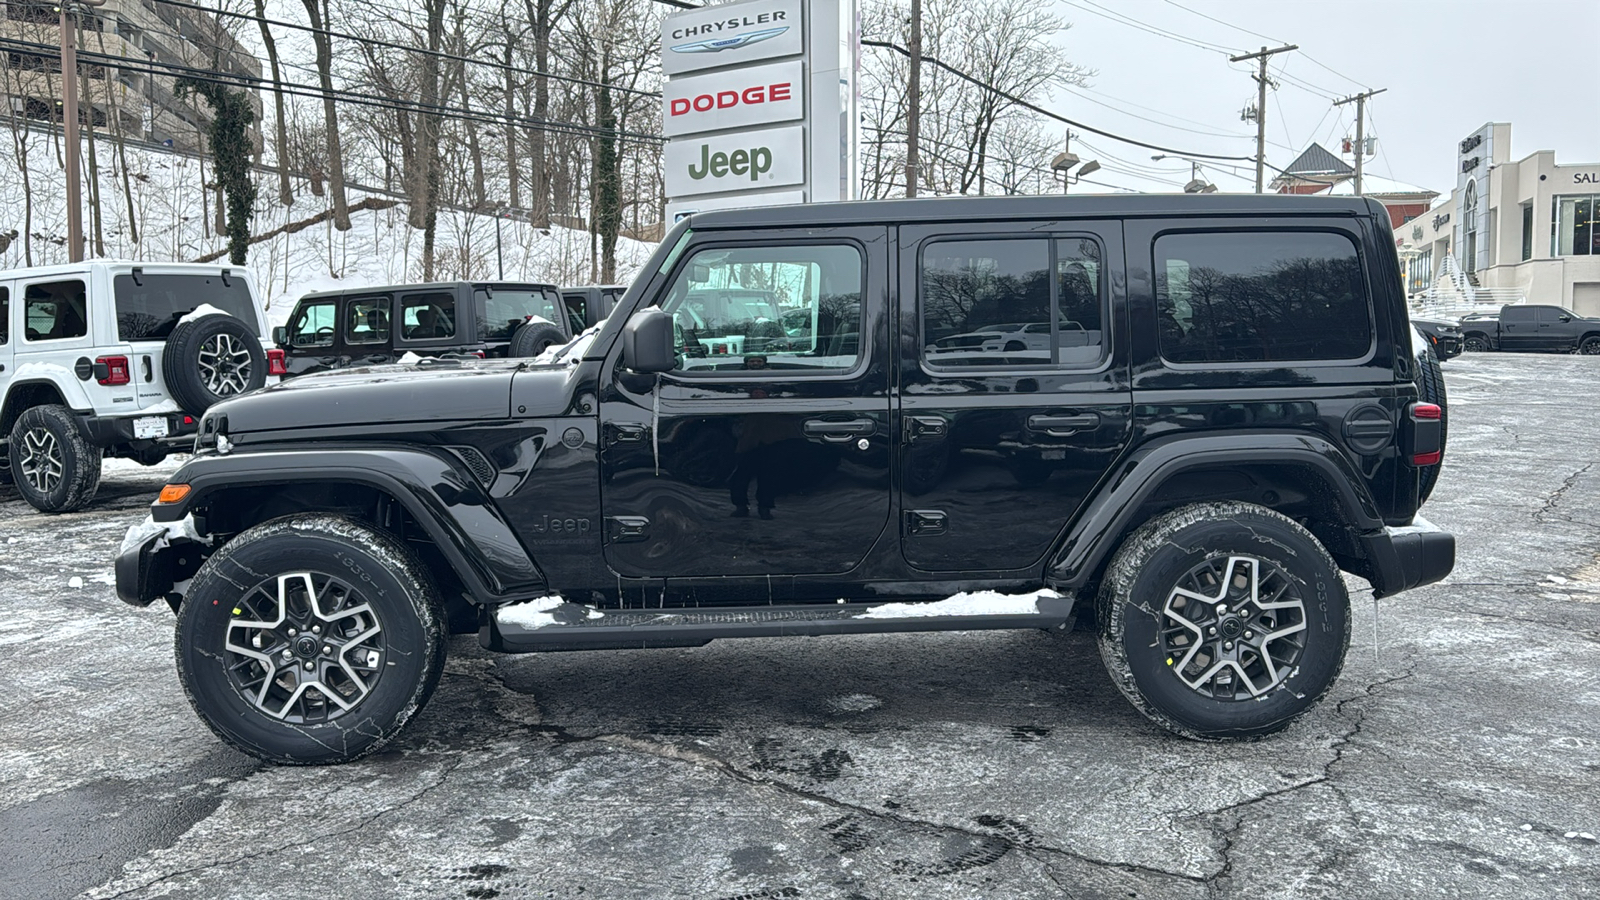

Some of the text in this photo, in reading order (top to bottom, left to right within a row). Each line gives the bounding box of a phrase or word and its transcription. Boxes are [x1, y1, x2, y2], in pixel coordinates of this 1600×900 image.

[672, 11, 786, 39] CHRYSLER
[671, 83, 791, 116] DODGE
[688, 144, 773, 181] Jeep
[1573, 173, 1600, 184] SAL
[533, 514, 590, 536] Jeep
